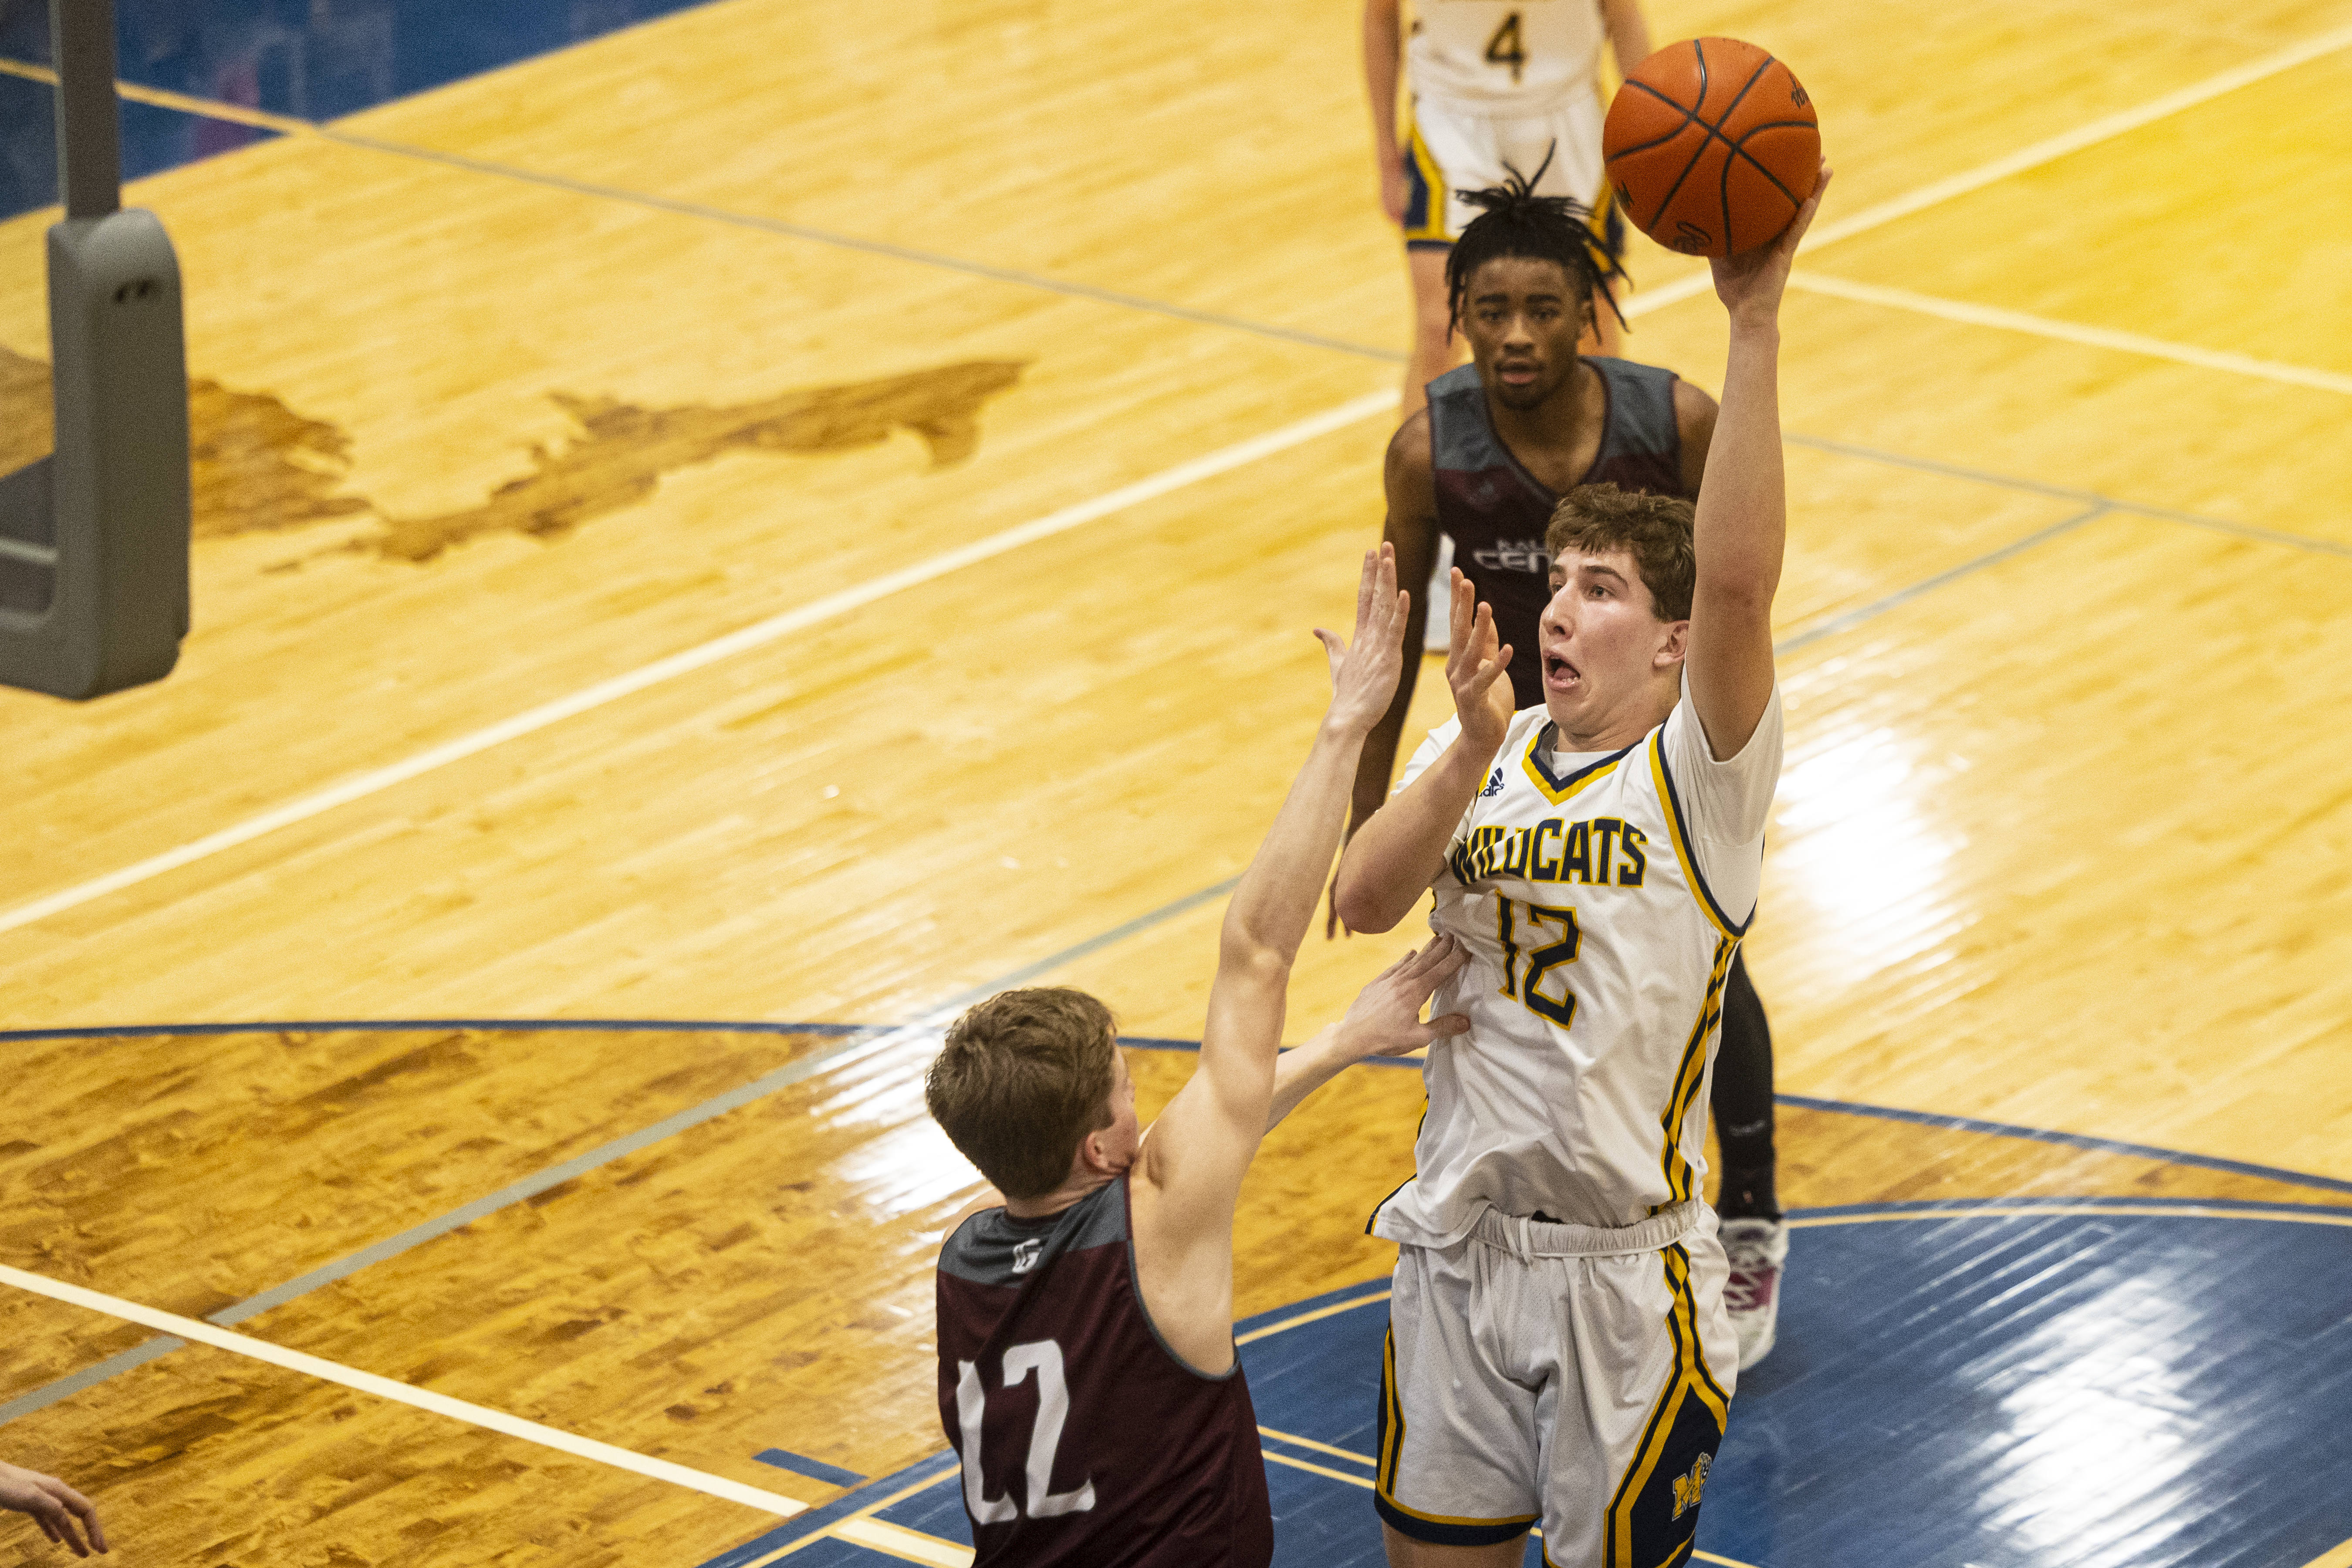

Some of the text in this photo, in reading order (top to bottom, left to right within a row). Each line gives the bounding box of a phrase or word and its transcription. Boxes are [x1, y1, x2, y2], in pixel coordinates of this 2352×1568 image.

[1482, 11, 1530, 84] 4
[1451, 816, 1648, 888] WILDCATS
[1496, 887, 1582, 1031] 12
[956, 1339, 1096, 1525] 12
